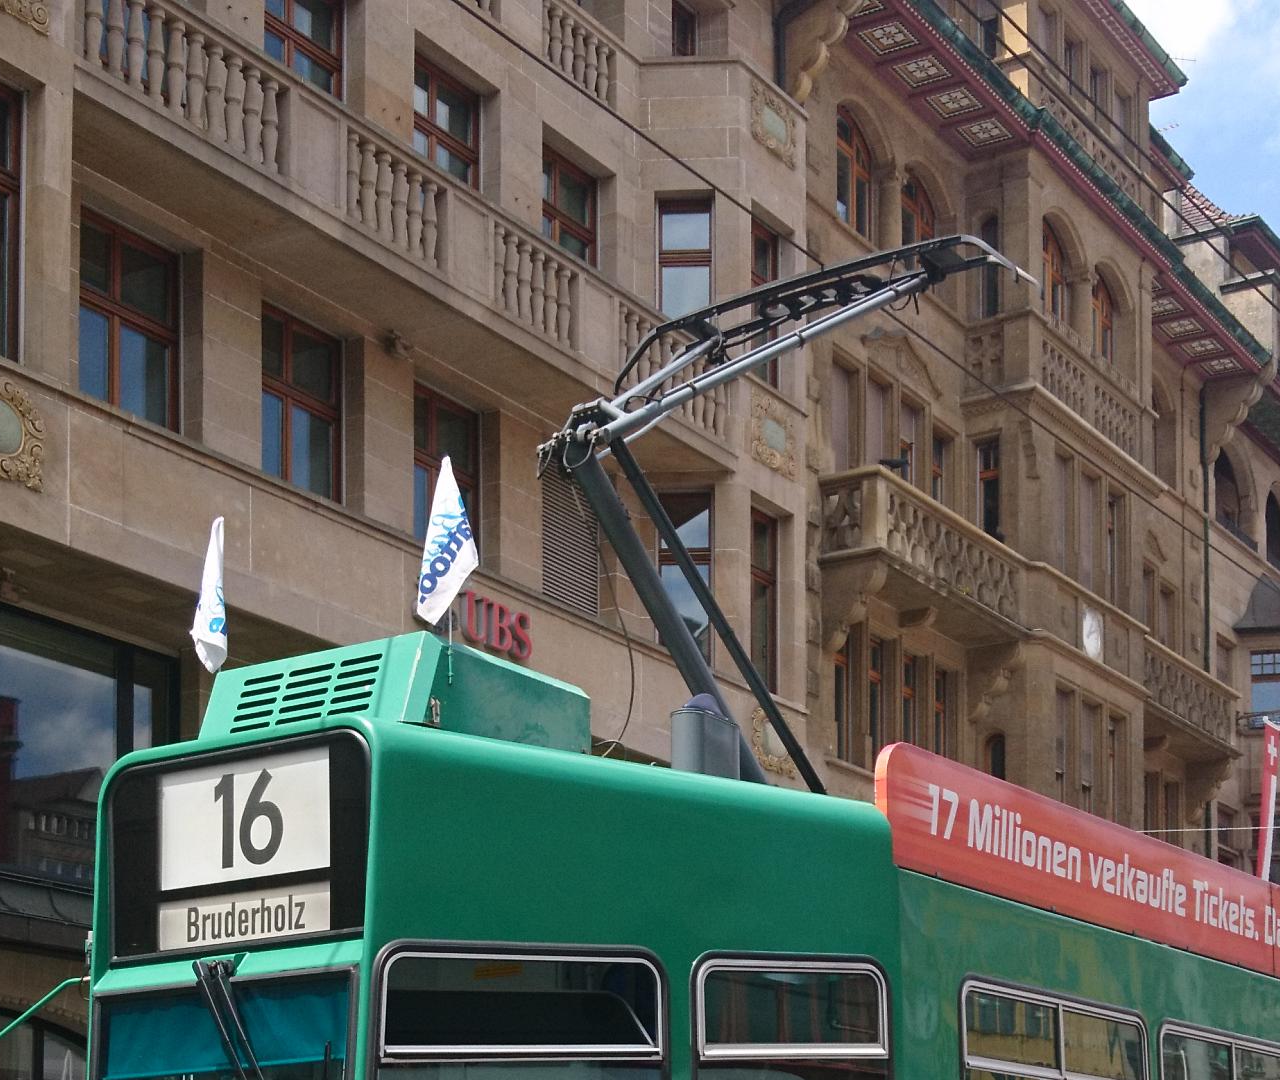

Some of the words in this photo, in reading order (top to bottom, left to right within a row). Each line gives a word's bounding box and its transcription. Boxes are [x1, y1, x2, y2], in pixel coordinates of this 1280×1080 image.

[464, 590, 533, 661] UBS
[214, 768, 284, 870] 16
[928, 784, 959, 840] 17
[967, 799, 1081, 883] Millionen
[1088, 854, 1186, 917] verkaufte
[1192, 880, 1259, 941] Tickets.
[187, 895, 306, 943] Bruderholz
